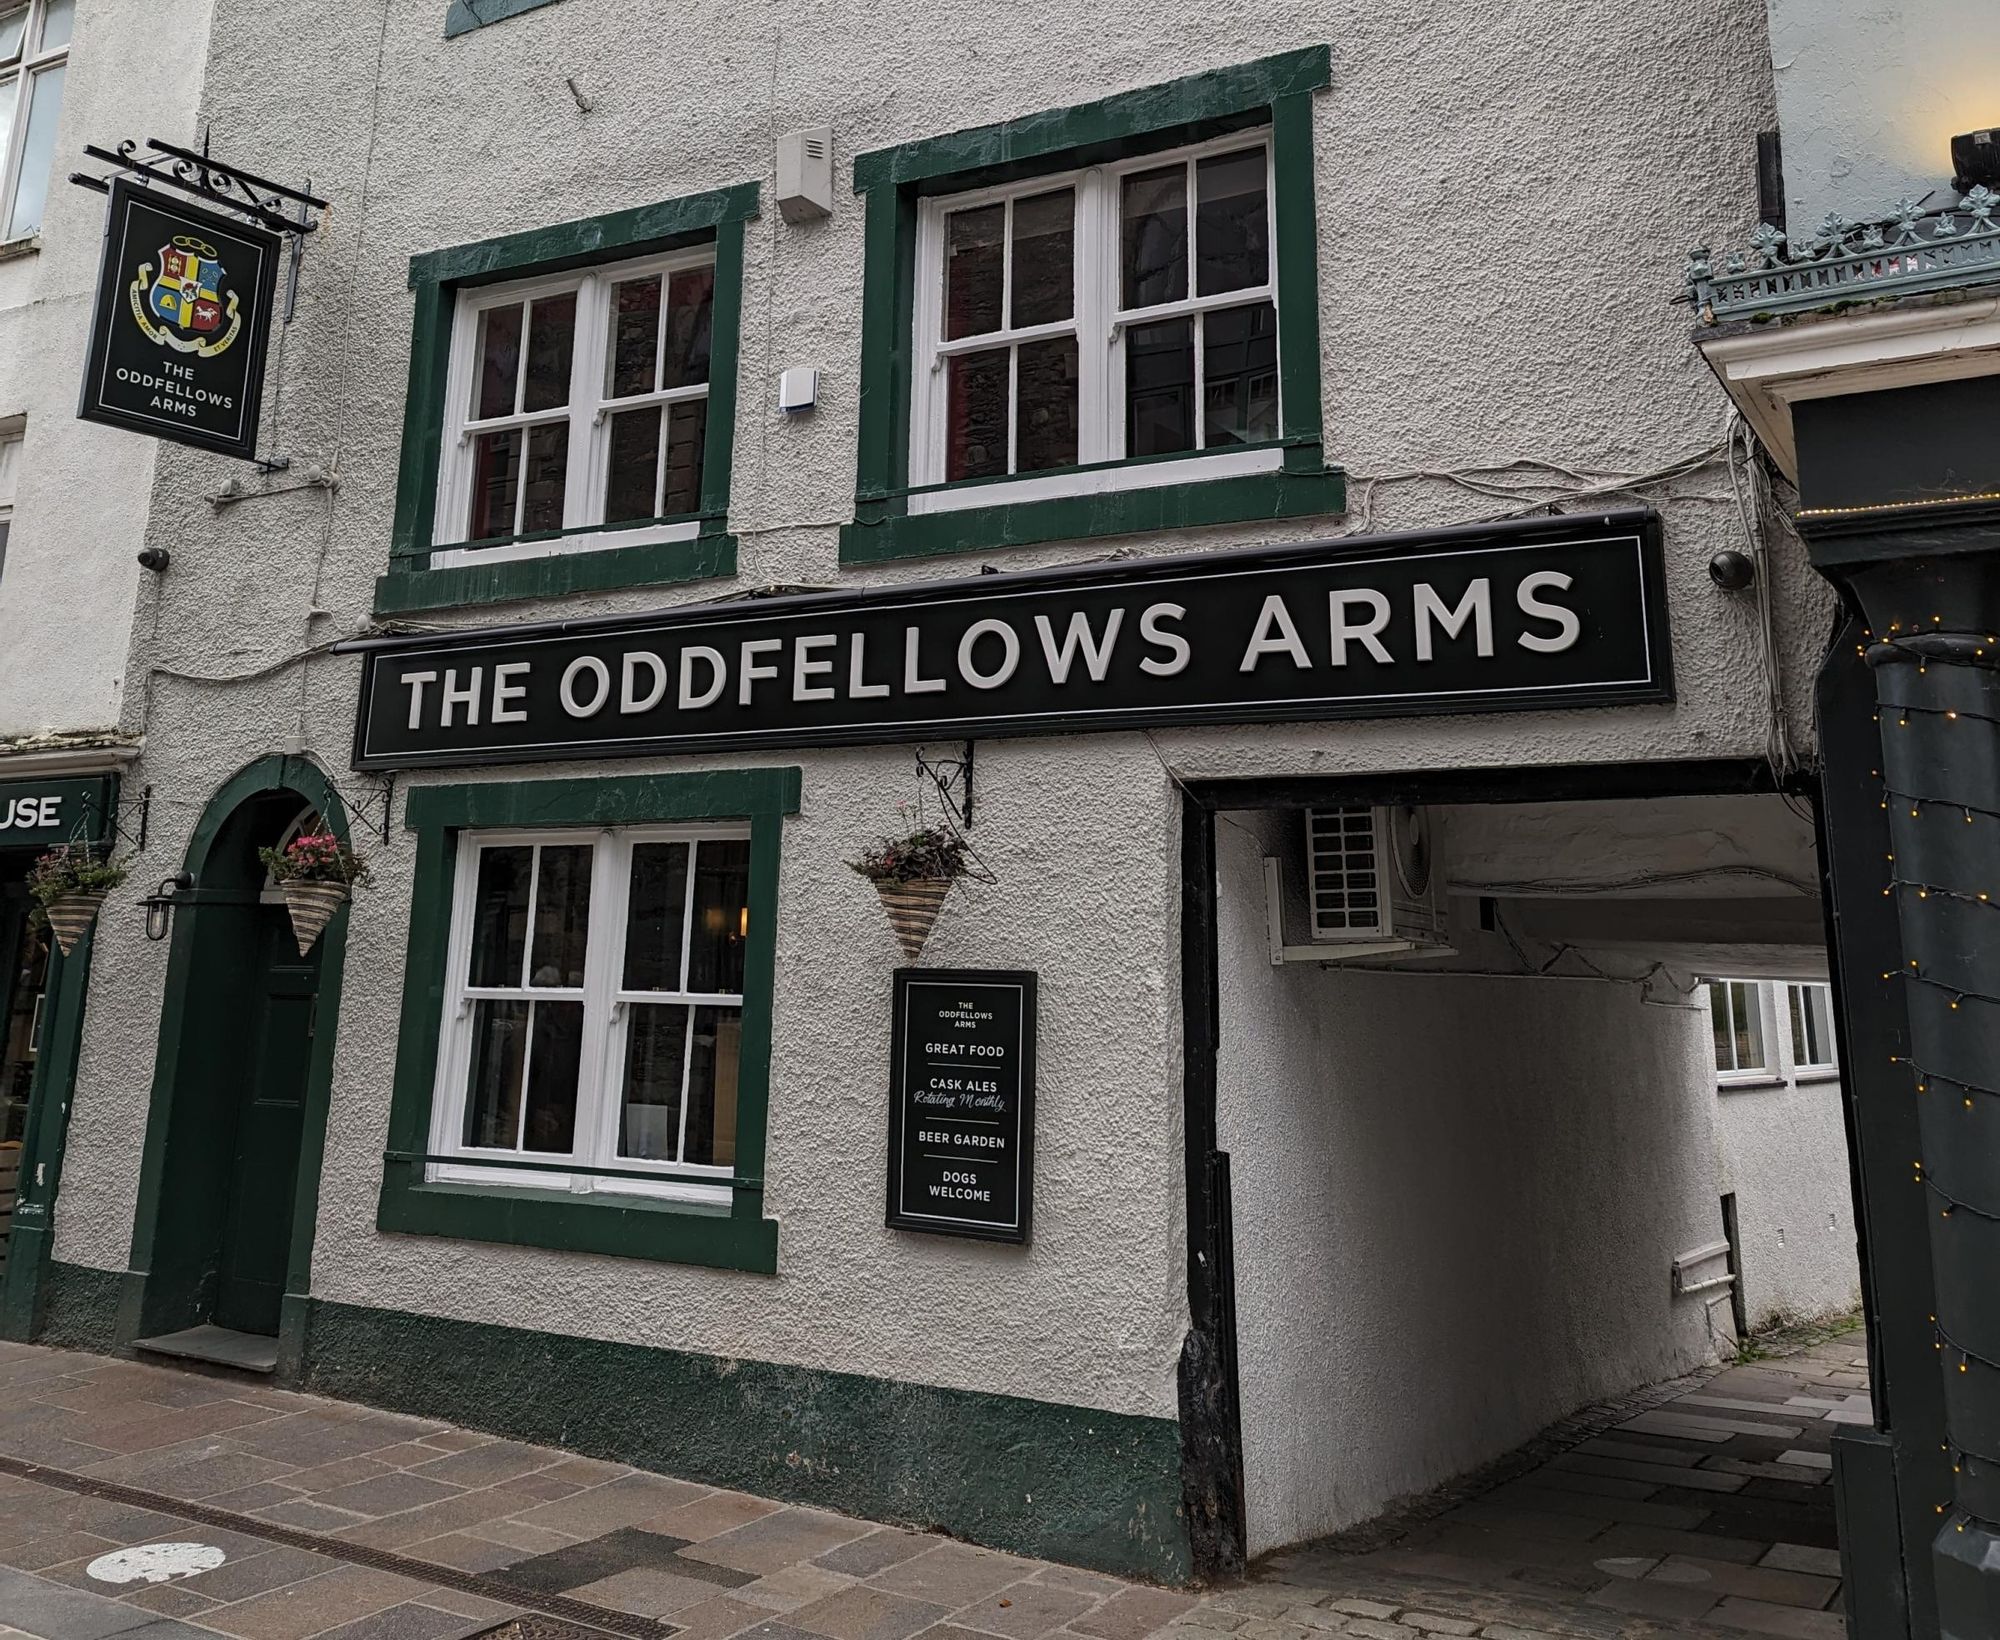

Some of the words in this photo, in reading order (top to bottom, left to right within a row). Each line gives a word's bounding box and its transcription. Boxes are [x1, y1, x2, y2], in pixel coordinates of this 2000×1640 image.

[141, 321, 158, 340] AMOR
[220, 326, 238, 347] VERITAS
[163, 361, 195, 381] THE
[116, 367, 233, 409] ODDFELLOWS
[150, 395, 197, 417] ARMS
[401, 662, 531, 730] THE
[560, 602, 1191, 719] ODDFELLOWS
[1239, 571, 1581, 674] ARMS
[958, 1001, 973, 1010] THE
[938, 1010, 993, 1020] ODDFELLOWS
[954, 1020, 976, 1029] ARMS
[925, 1042, 965, 1055] GREAT
[969, 1044, 1004, 1057] FOOD
[930, 1078, 962, 1091] CASK
[966, 1080, 997, 1093] ALES
[913, 1090, 955, 1108] Rotating
[959, 1093, 1006, 1112] Monthly
[918, 1131, 949, 1144] BEER
[954, 1133, 1005, 1149] GARDEN
[942, 1171, 977, 1185] DOGS
[929, 1185, 991, 1202] WELCOME
